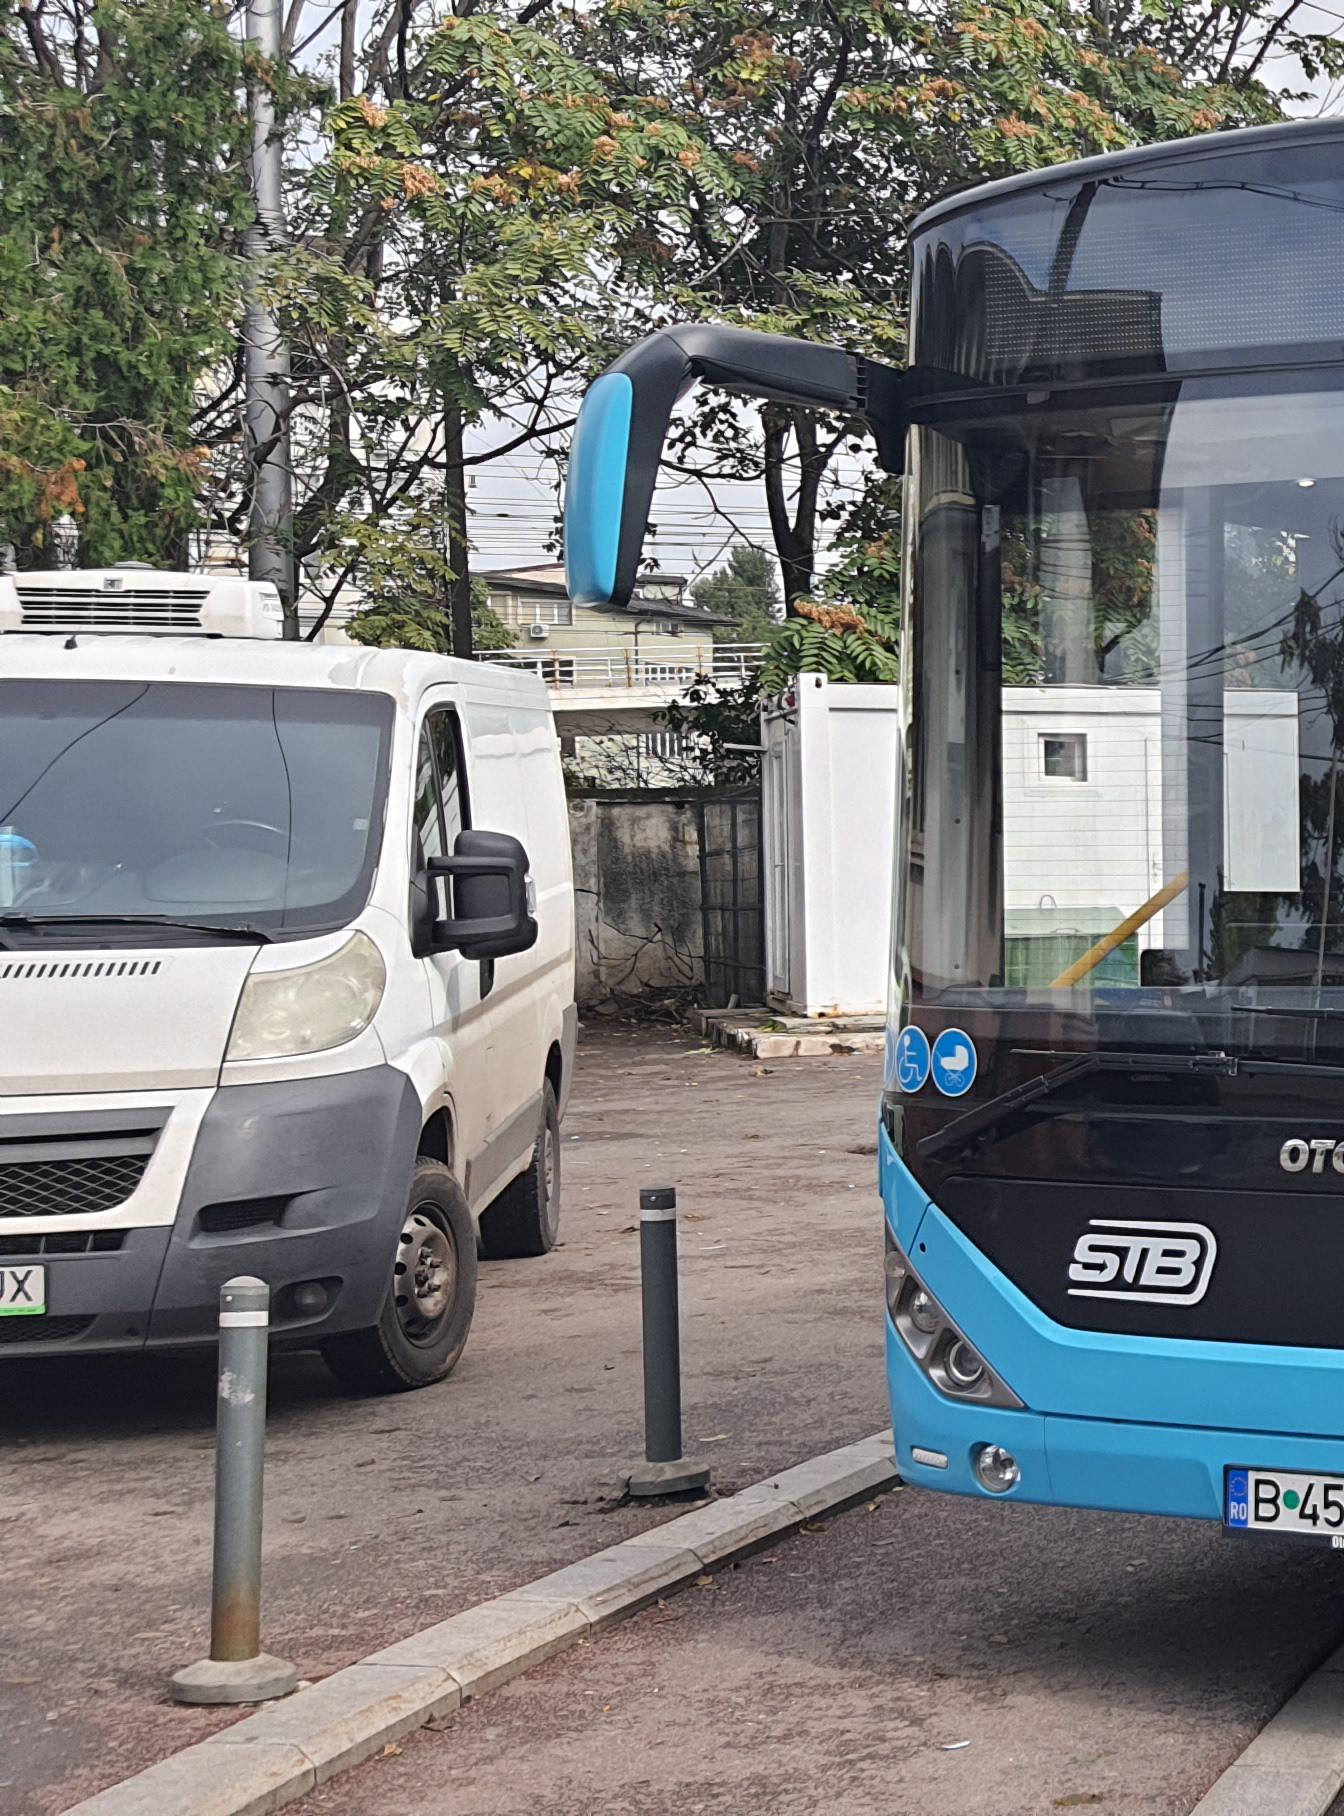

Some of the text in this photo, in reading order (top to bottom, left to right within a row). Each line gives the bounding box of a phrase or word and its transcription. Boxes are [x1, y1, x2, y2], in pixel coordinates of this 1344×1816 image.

[1068, 1232, 1202, 1289] STB
[1230, 1501, 1247, 1520] RO
[1254, 1478, 1281, 1522] B
